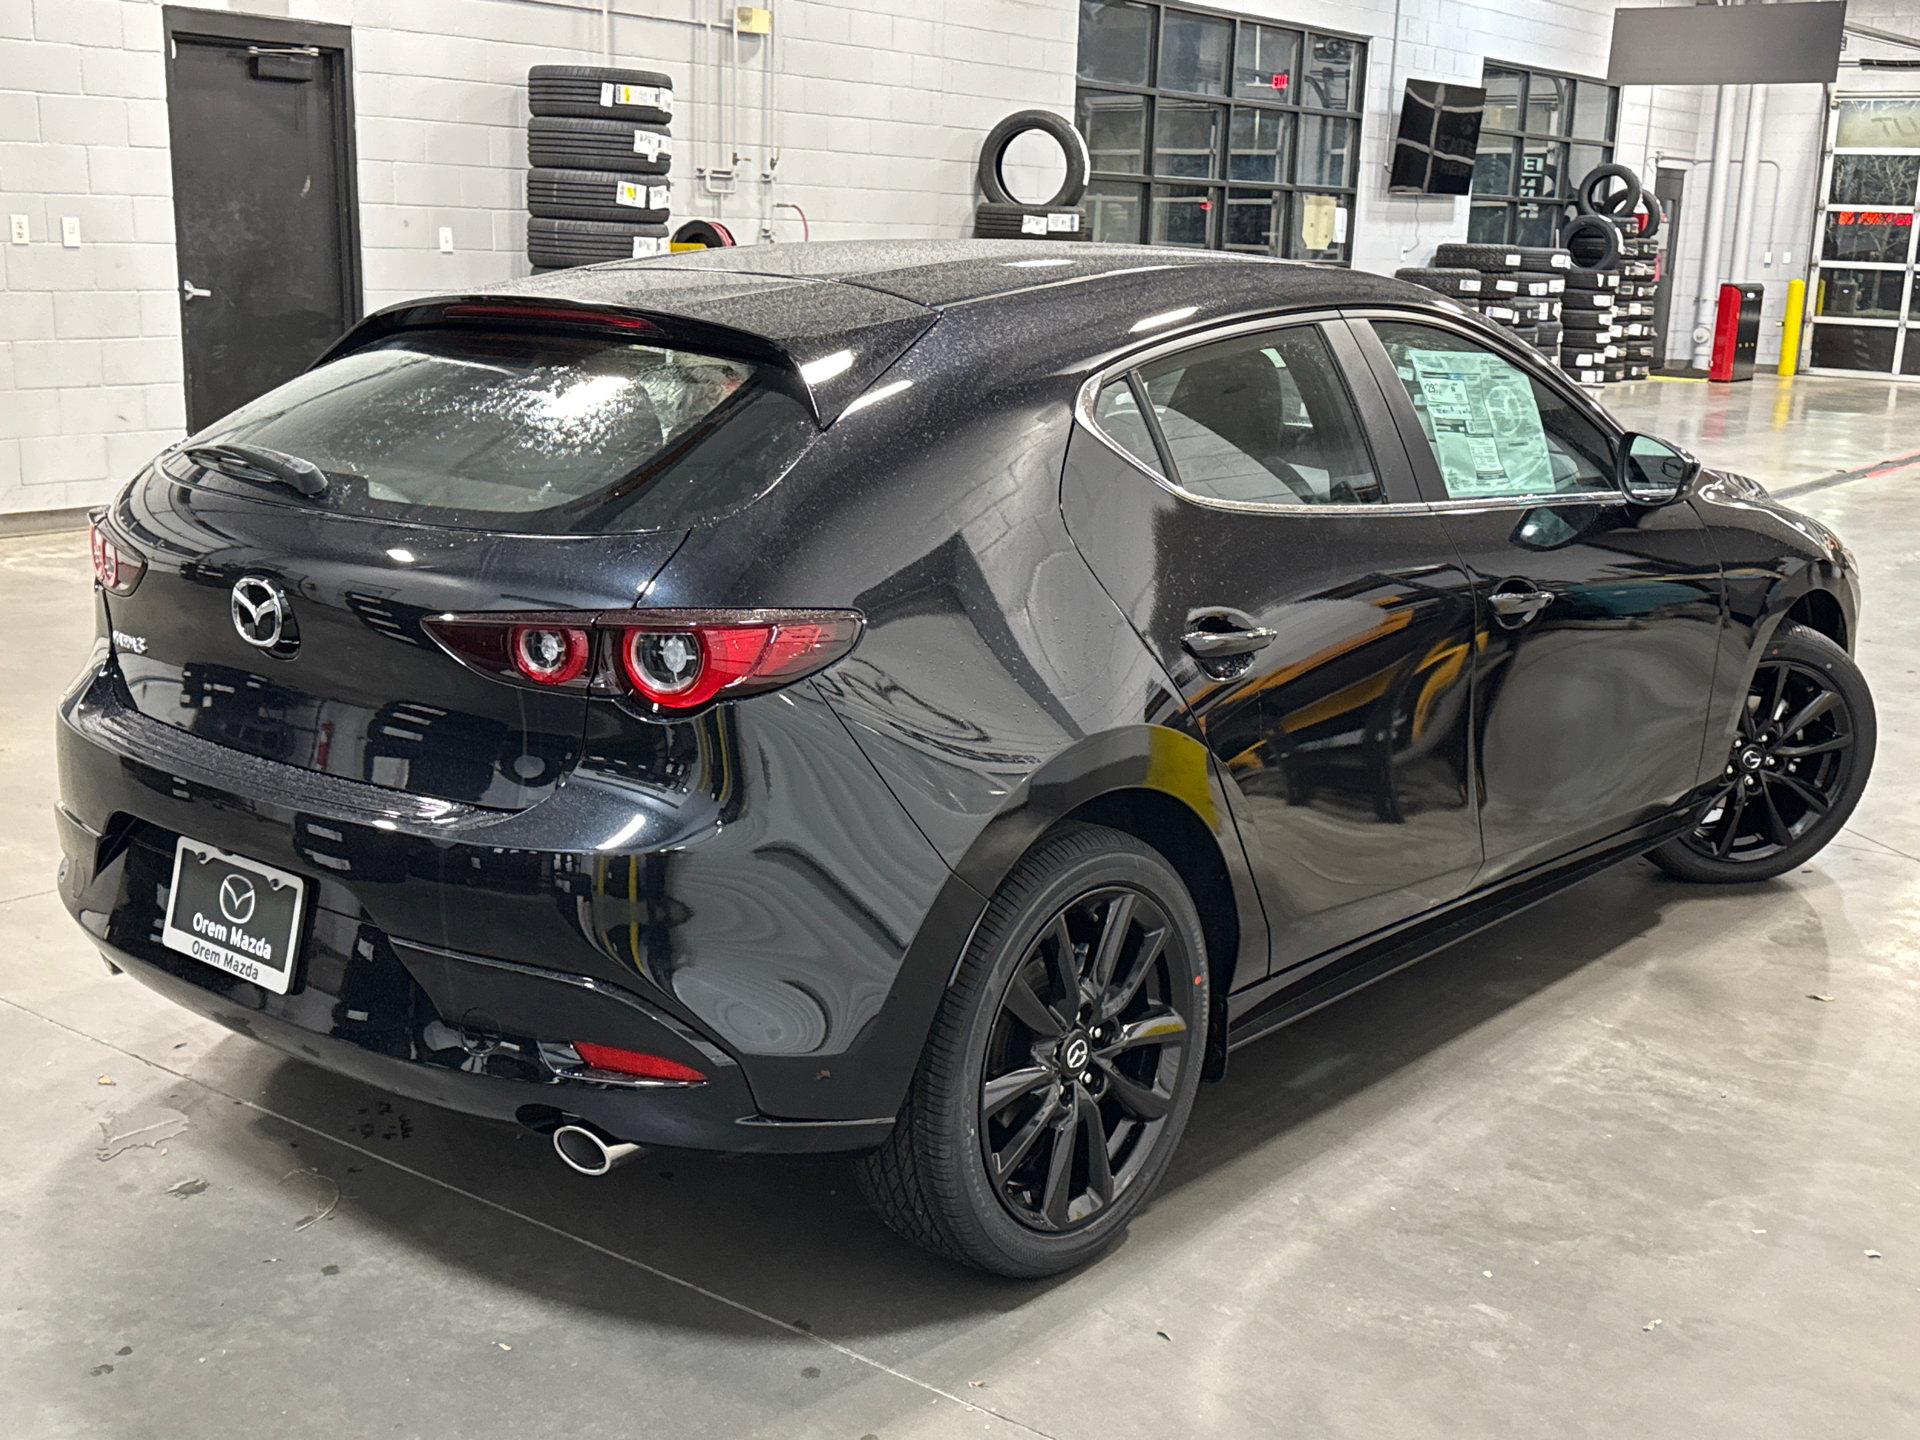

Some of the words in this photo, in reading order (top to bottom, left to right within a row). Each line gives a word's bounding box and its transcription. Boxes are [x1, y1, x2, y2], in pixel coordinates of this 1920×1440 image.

[193, 912, 227, 942] Orem
[230, 926, 272, 960] Mazda
[192, 940, 221, 965] Orem
[223, 952, 259, 980] Mazda
